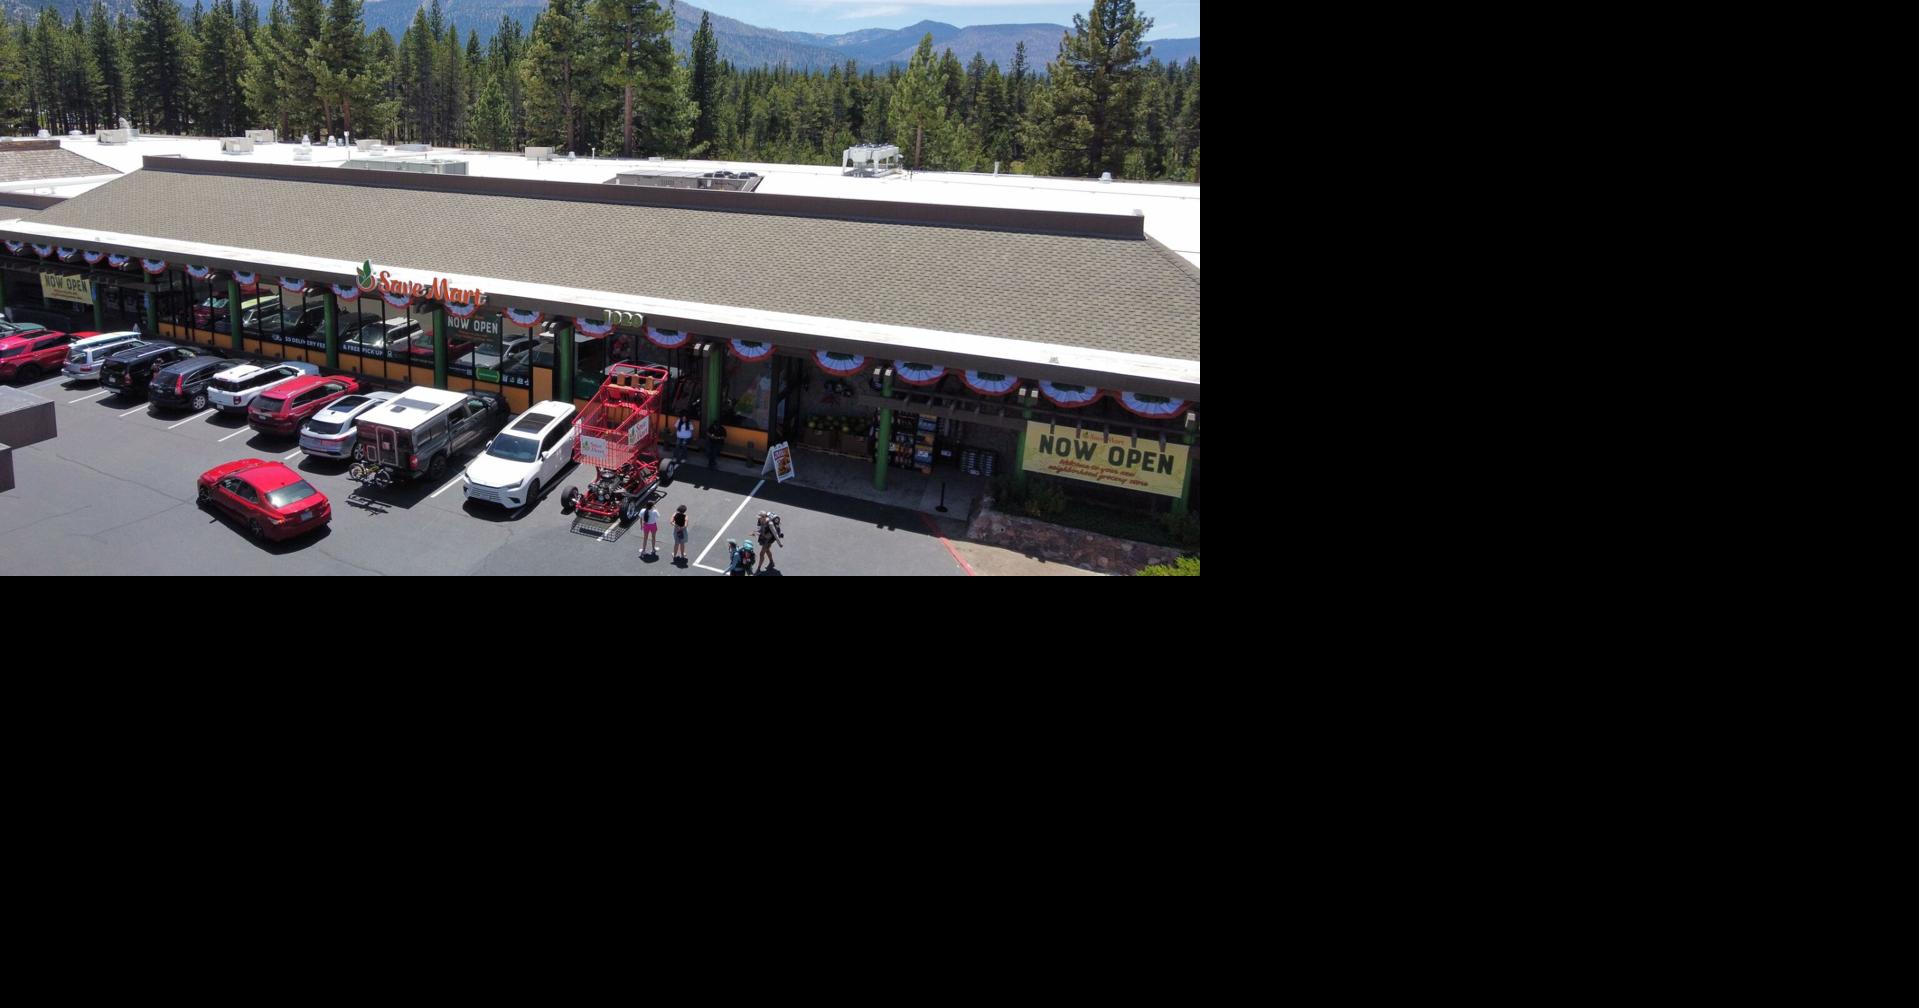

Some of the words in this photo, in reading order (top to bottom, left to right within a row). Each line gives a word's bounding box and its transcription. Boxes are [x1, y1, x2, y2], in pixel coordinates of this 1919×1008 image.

[45, 274, 63, 288] NOW
[66, 278, 88, 293] OPEN
[379, 270, 424, 297] Save
[426, 277, 485, 306] Mart
[447, 315, 470, 330] NOW
[473, 320, 498, 334] OPEN
[348, 344, 360, 352] FREE
[1039, 434, 1097, 461] NOW
[1108, 446, 1174, 475] OPEN
[1097, 474, 1128, 485] grocery
